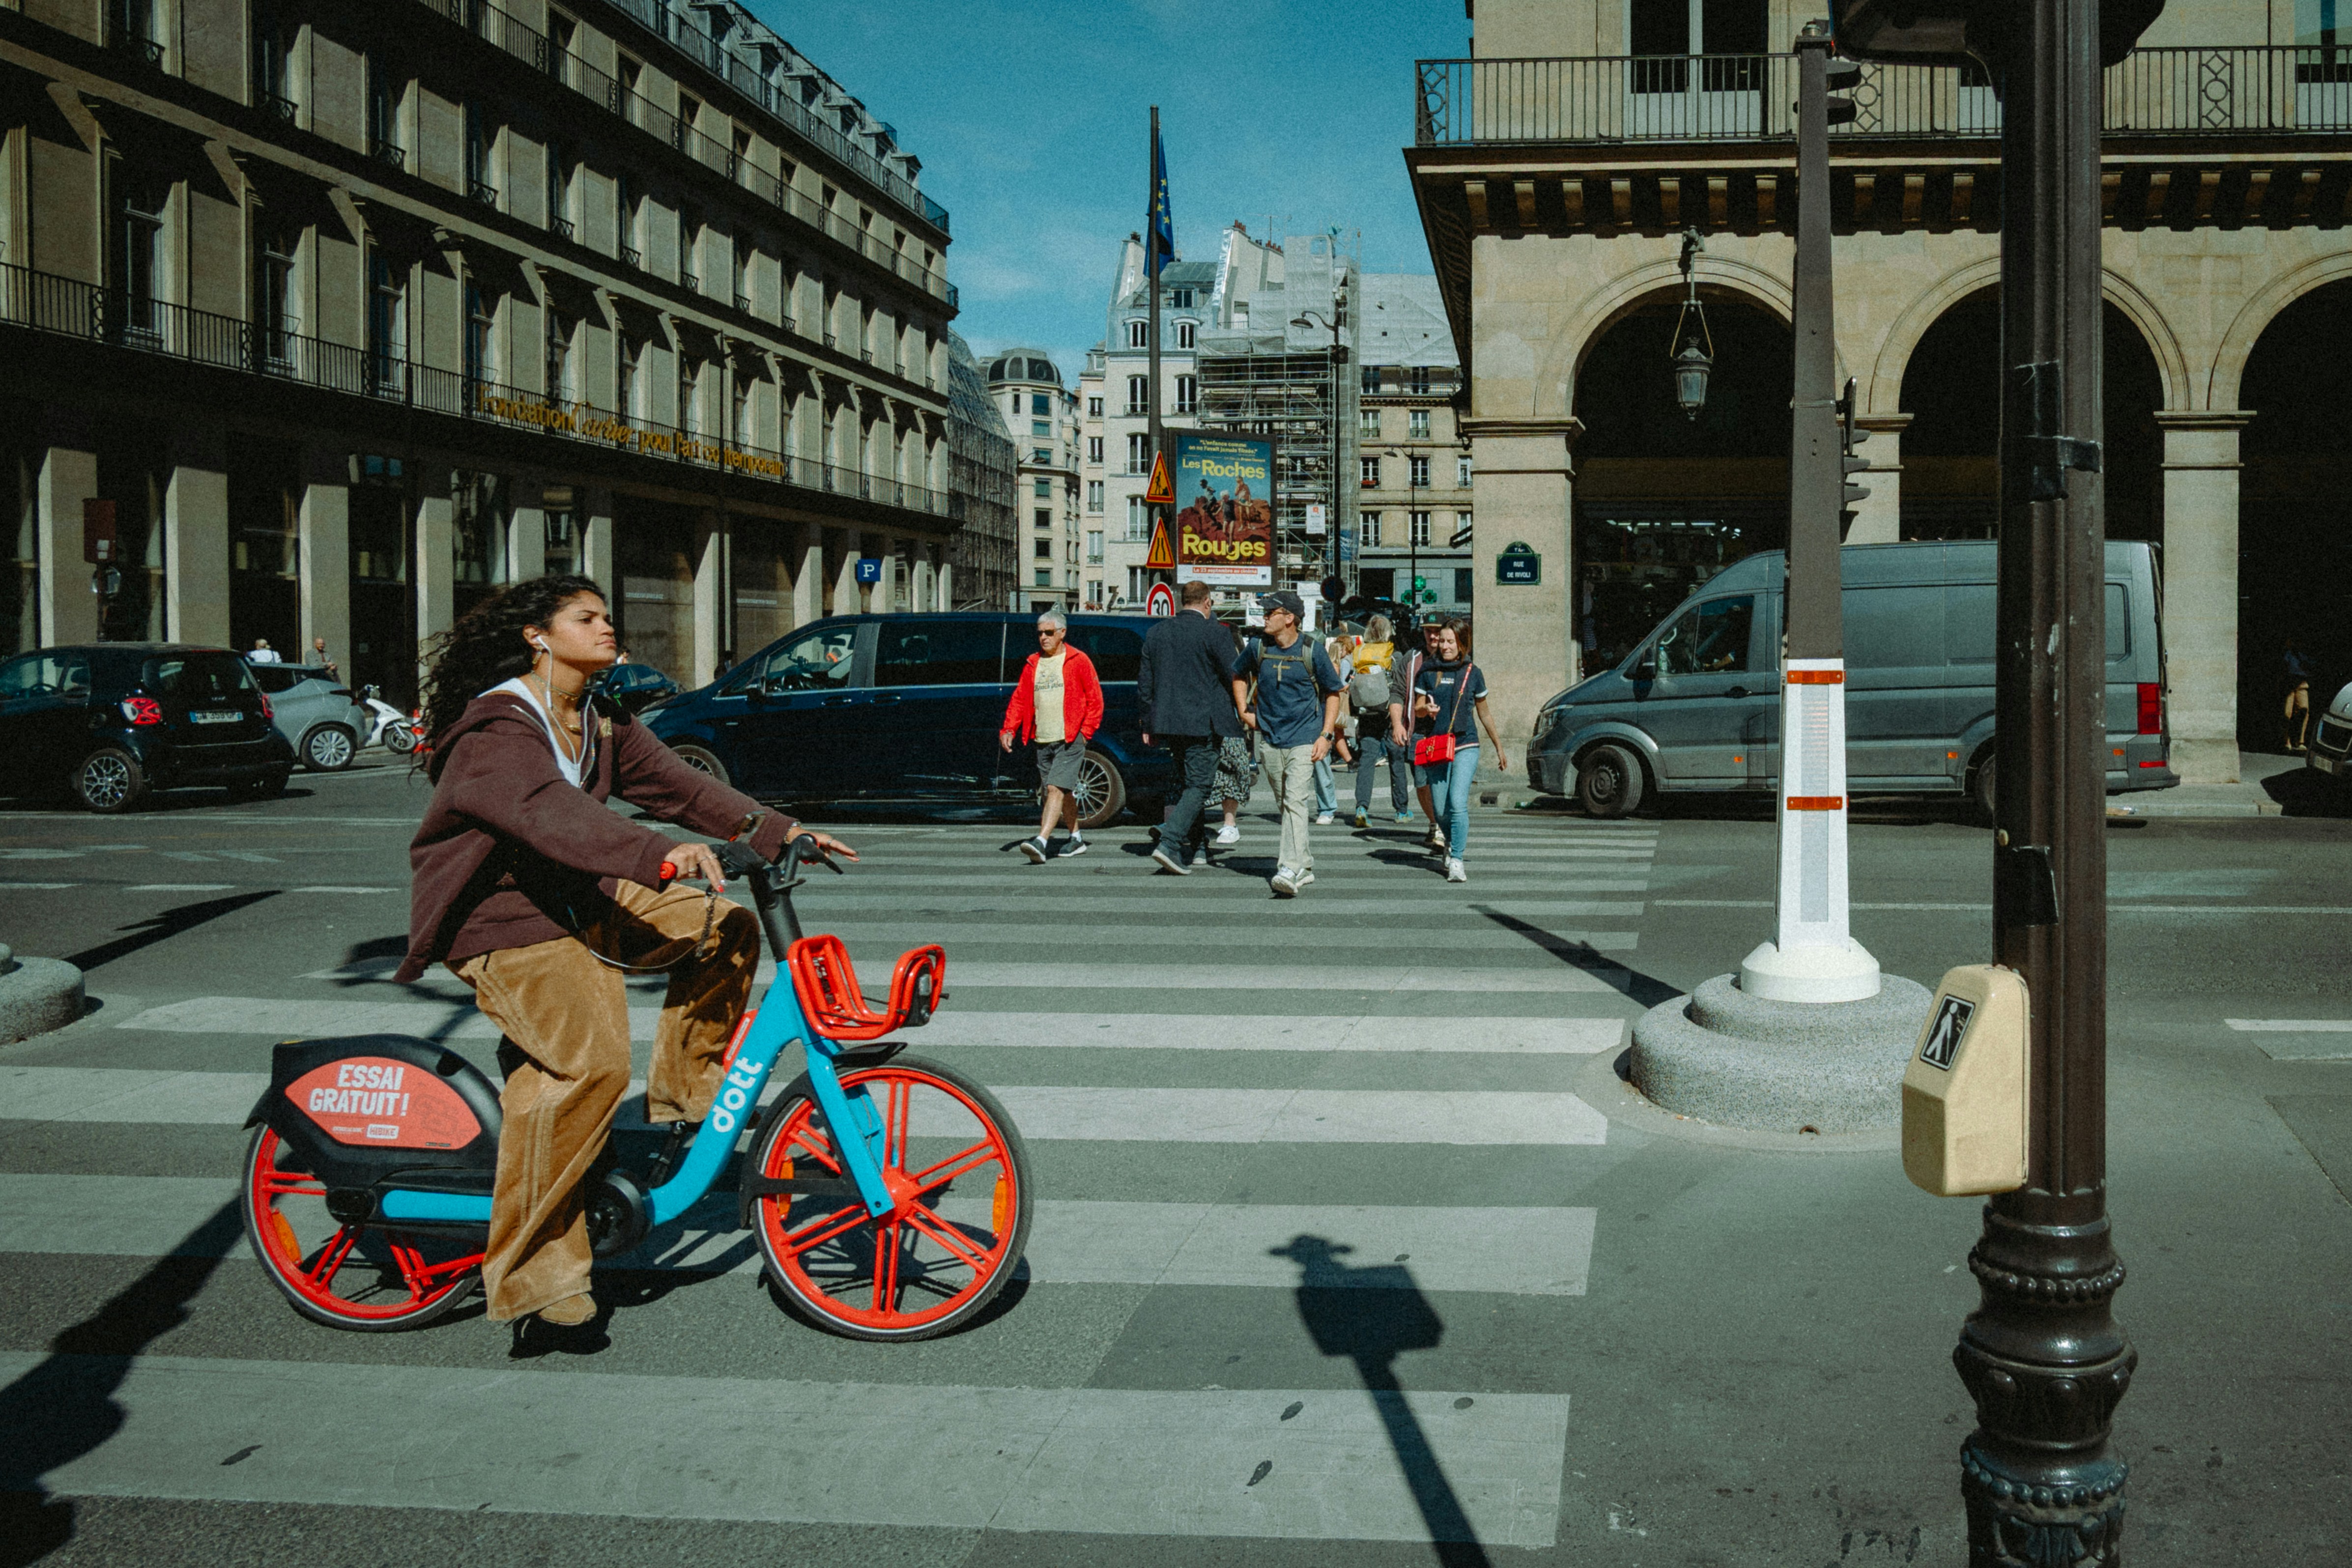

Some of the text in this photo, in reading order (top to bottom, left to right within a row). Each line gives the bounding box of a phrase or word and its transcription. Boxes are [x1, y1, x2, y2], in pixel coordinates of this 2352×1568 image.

[476, 384, 785, 476] Fondation Cartier pour l'art cotemporain
[1182, 458, 1265, 479] Les Roches
[1183, 533, 1266, 560] Rouges
[863, 564, 875, 577] P
[1153, 599, 1170, 615] 30
[337, 1064, 404, 1090] ESSAI
[713, 1056, 764, 1133] dott
